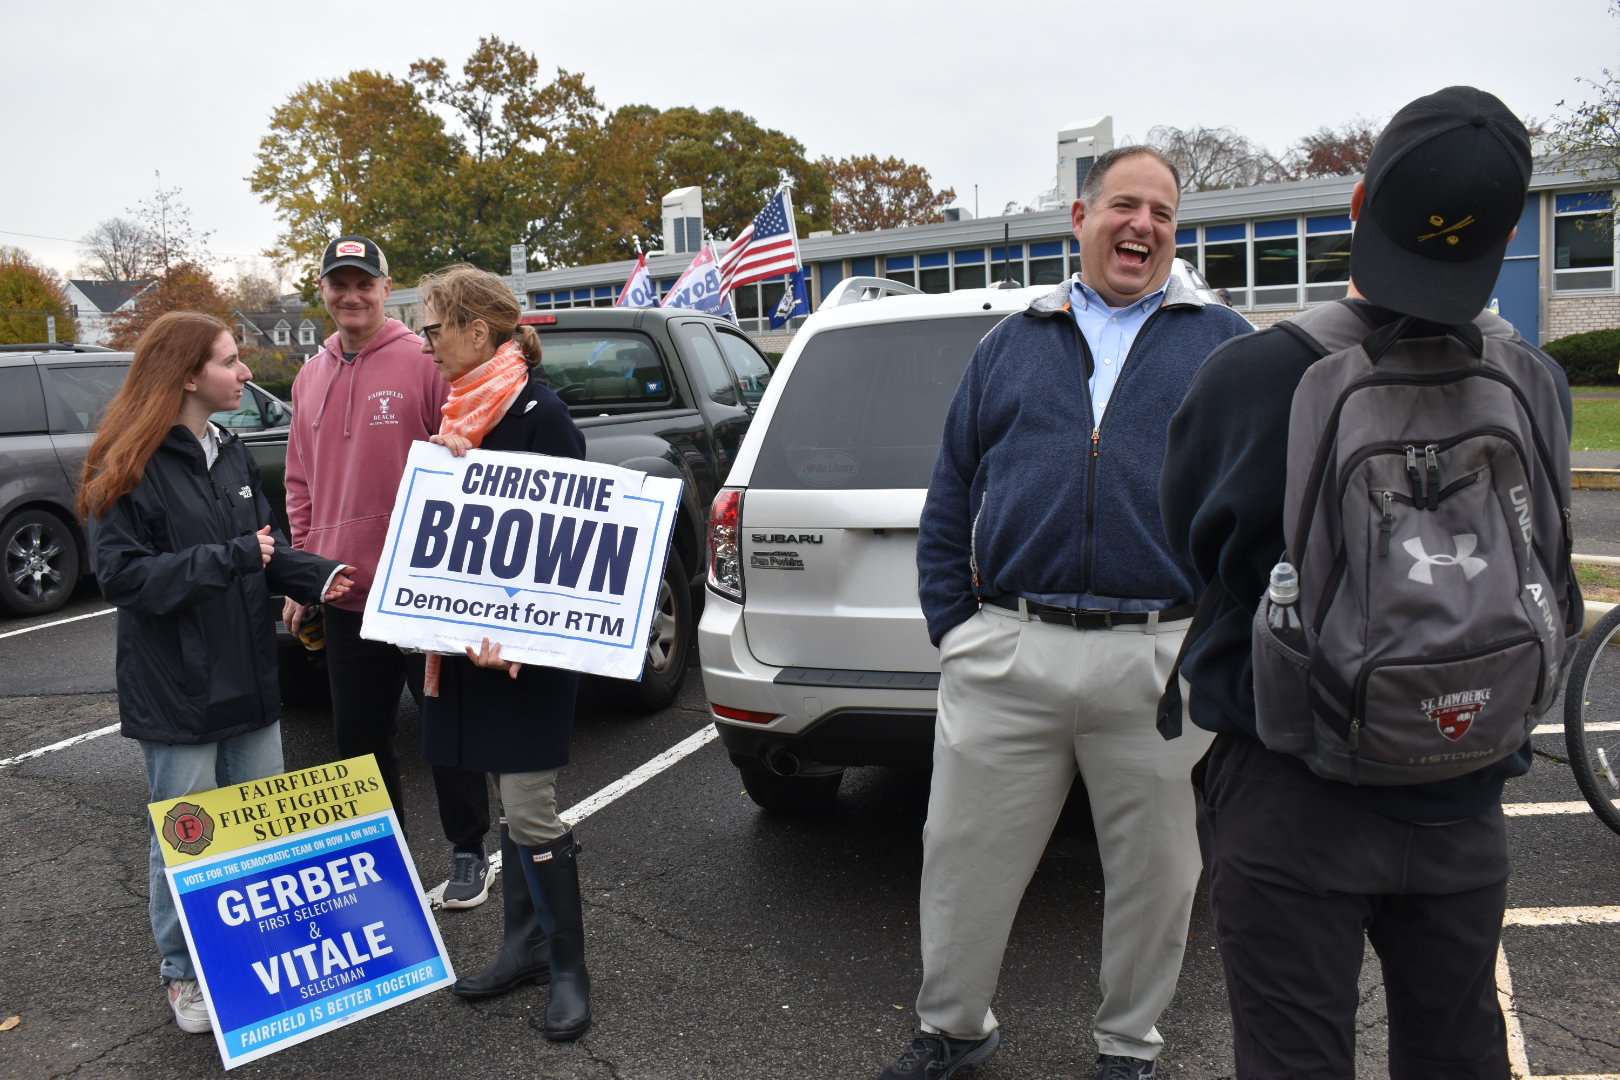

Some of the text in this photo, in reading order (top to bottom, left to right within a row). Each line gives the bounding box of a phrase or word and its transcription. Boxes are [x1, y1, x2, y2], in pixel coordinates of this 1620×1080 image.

[368, 390, 404, 400] FAIRFIELD
[462, 462, 615, 512] CHRISTINE
[409, 499, 638, 596] BROWN
[752, 534, 822, 544] SUBARU
[394, 587, 625, 637] Democrat for RTM
[1420, 688, 1492, 710] ST. LAWRENCE
[1428, 748, 1494, 762] STORM
[218, 776, 380, 828] FIRE FIGHTERS
[238, 764, 349, 802] FAIRFIELD
[179, 818, 196, 840] F
[254, 800, 360, 842] SUPPORT
[183, 823, 385, 886] VOTE FOR THE DEMOCRATIC TEAM ON ROW A ON NOV. 7
[217, 852, 382, 926] GERBER
[258, 893, 358, 933] FIRST SELECTMAN
[309, 922, 322, 940] &
[251, 920, 394, 995] VITALE
[300, 966, 366, 999] SELECTMAN
[240, 965, 434, 1048] FAIRFIELD IS BETTER TOGETHER
